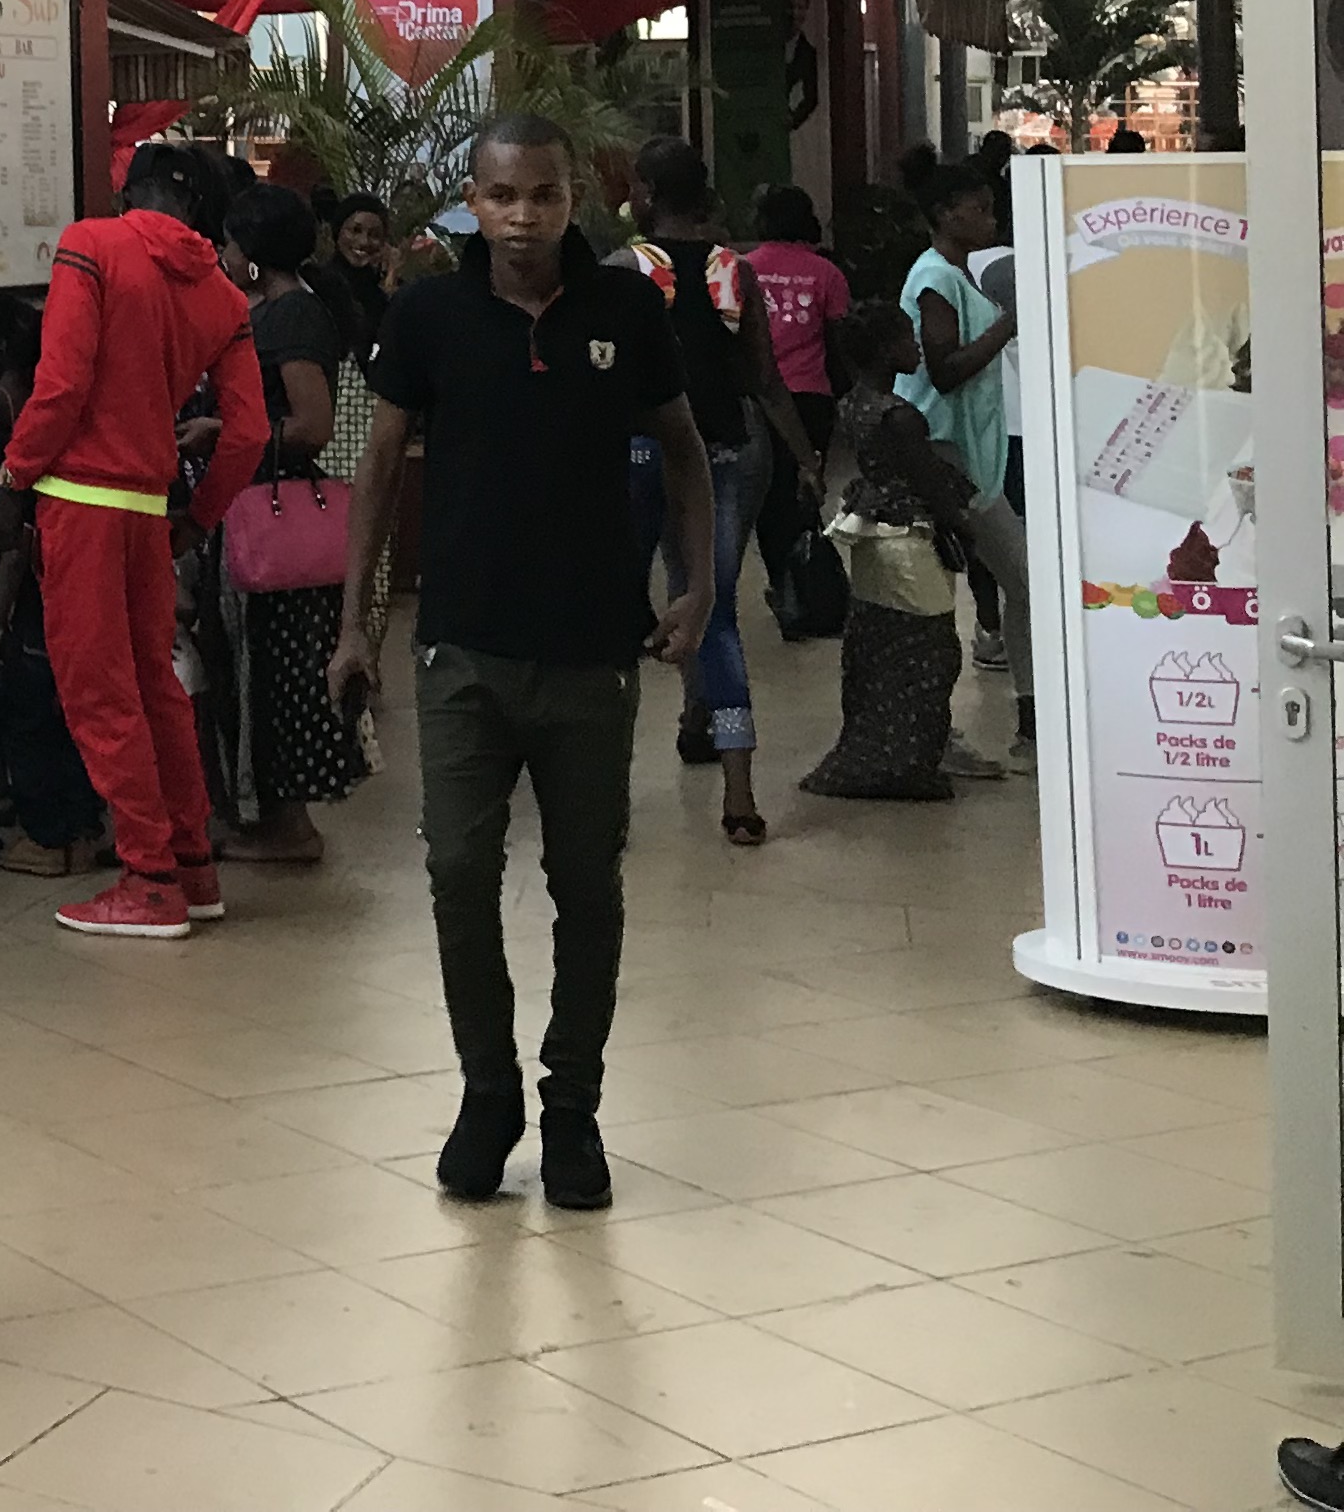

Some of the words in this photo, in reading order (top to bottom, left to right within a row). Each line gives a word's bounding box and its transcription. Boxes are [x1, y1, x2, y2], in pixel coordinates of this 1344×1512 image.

[1081, 199, 1231, 237] Expérience
[1156, 732, 1208, 749] Packs
[1213, 734, 1236, 751] de
[1163, 750, 1191, 767] 1/2
[1195, 751, 1231, 768] litre
[1167, 873, 1220, 891] Packs
[1224, 877, 1248, 893] de
[1185, 893, 1192, 908] 1
[1197, 893, 1232, 910] litre
